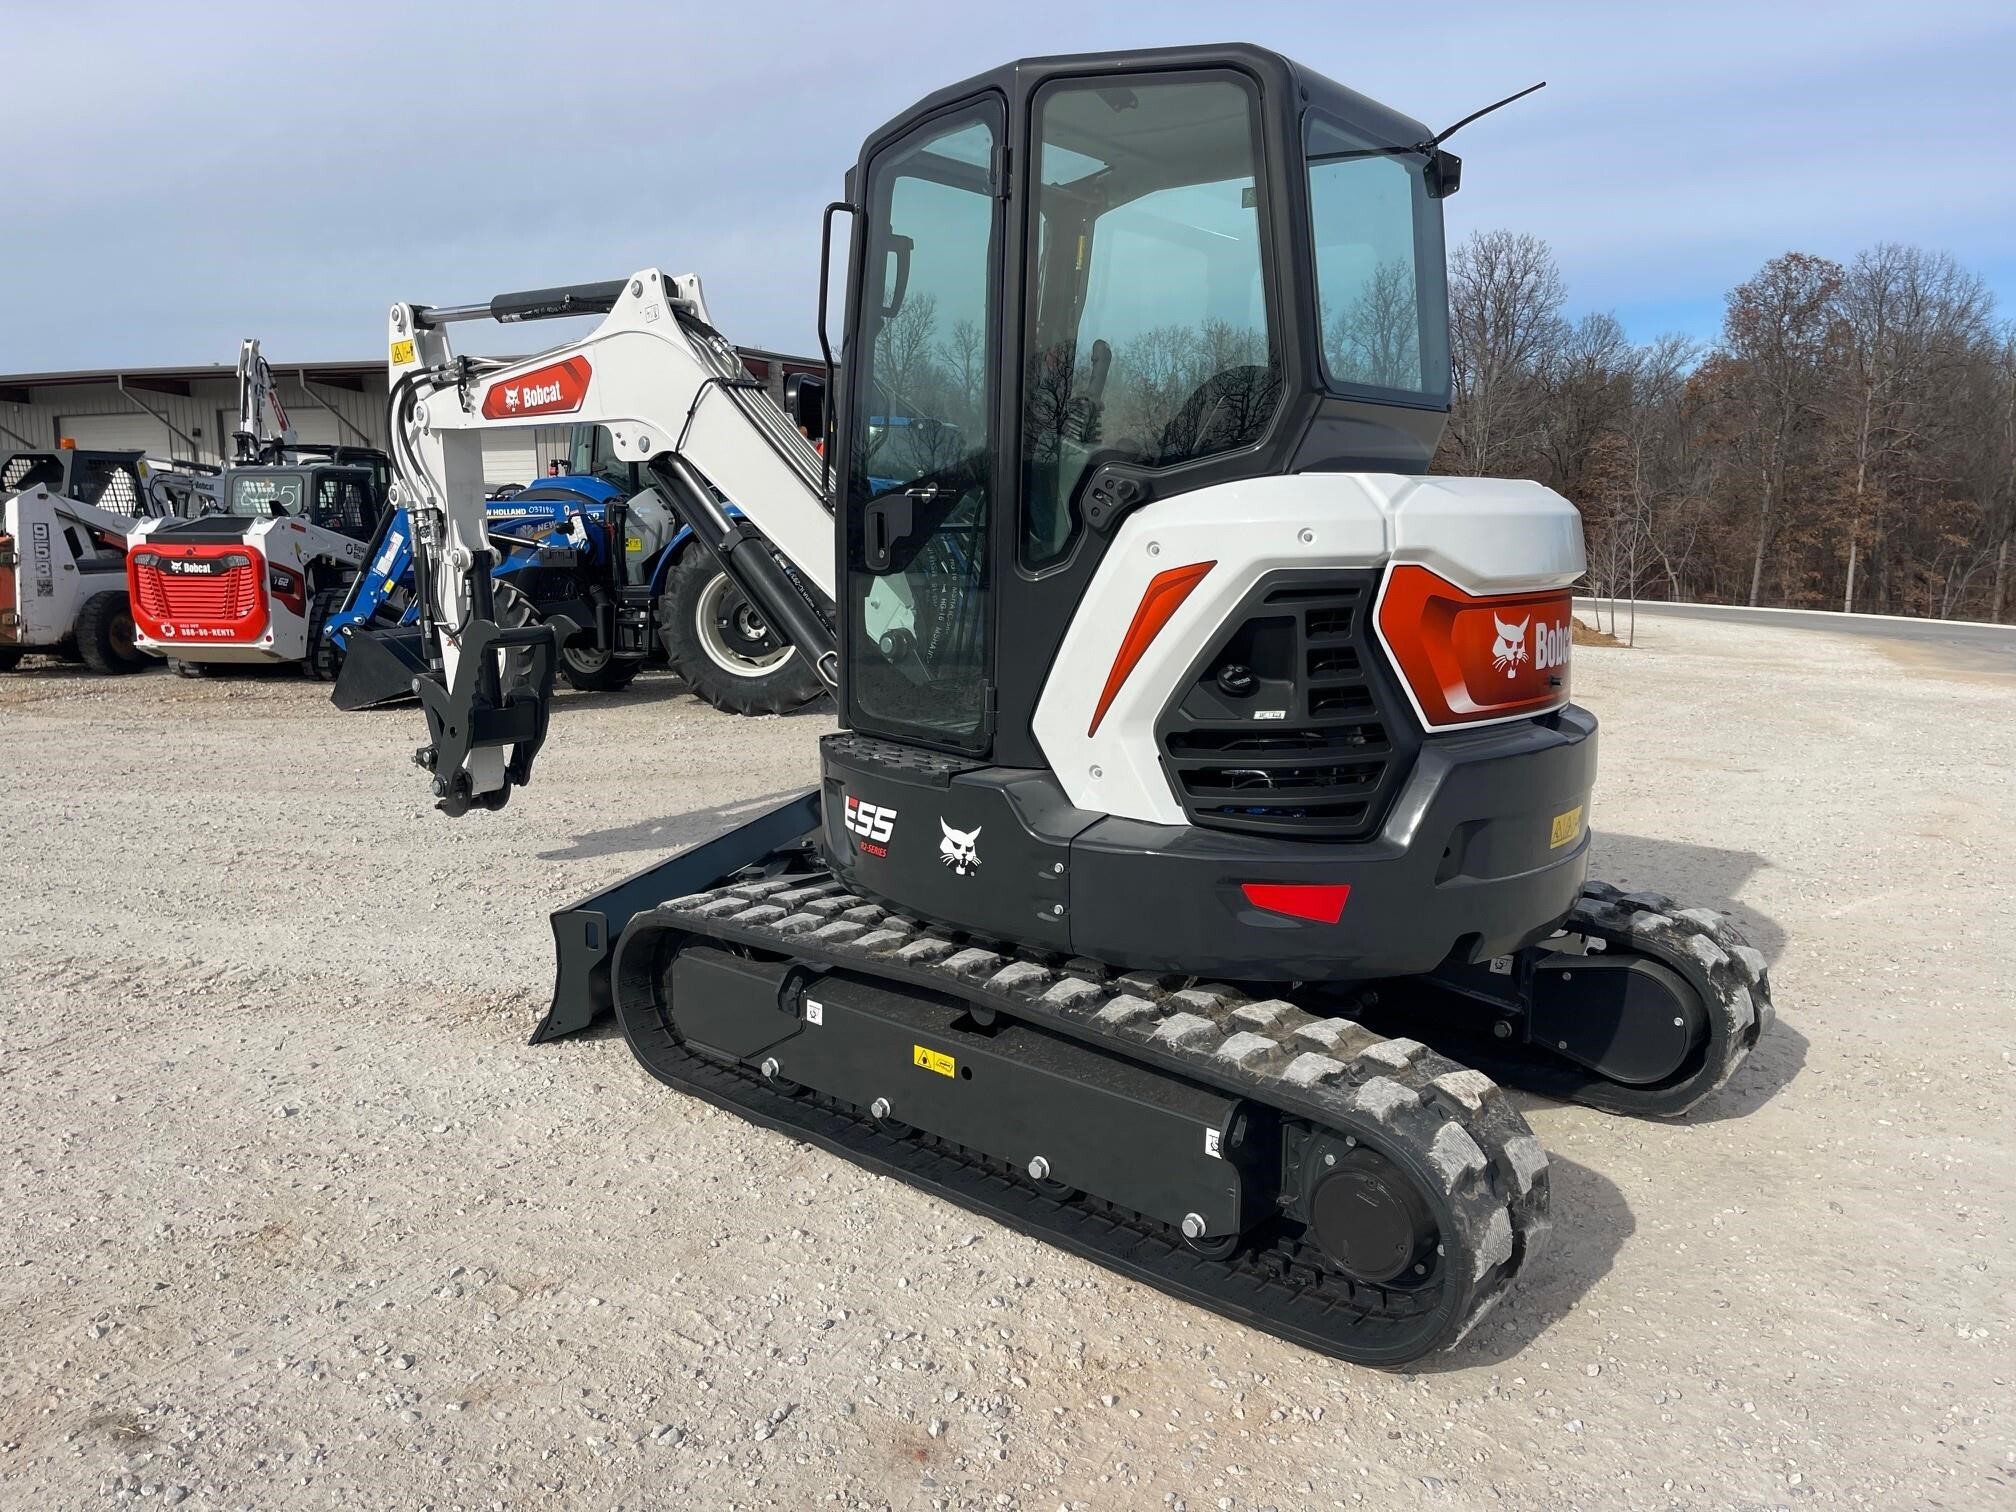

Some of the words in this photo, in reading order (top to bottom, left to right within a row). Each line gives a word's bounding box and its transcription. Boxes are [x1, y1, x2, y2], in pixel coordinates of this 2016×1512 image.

[523, 380, 561, 408] Bobcat
[493, 508, 527, 516] HOLLAND
[537, 520, 557, 532] NEW
[184, 562, 211, 573] Bobcat
[845, 794, 898, 843] E55
